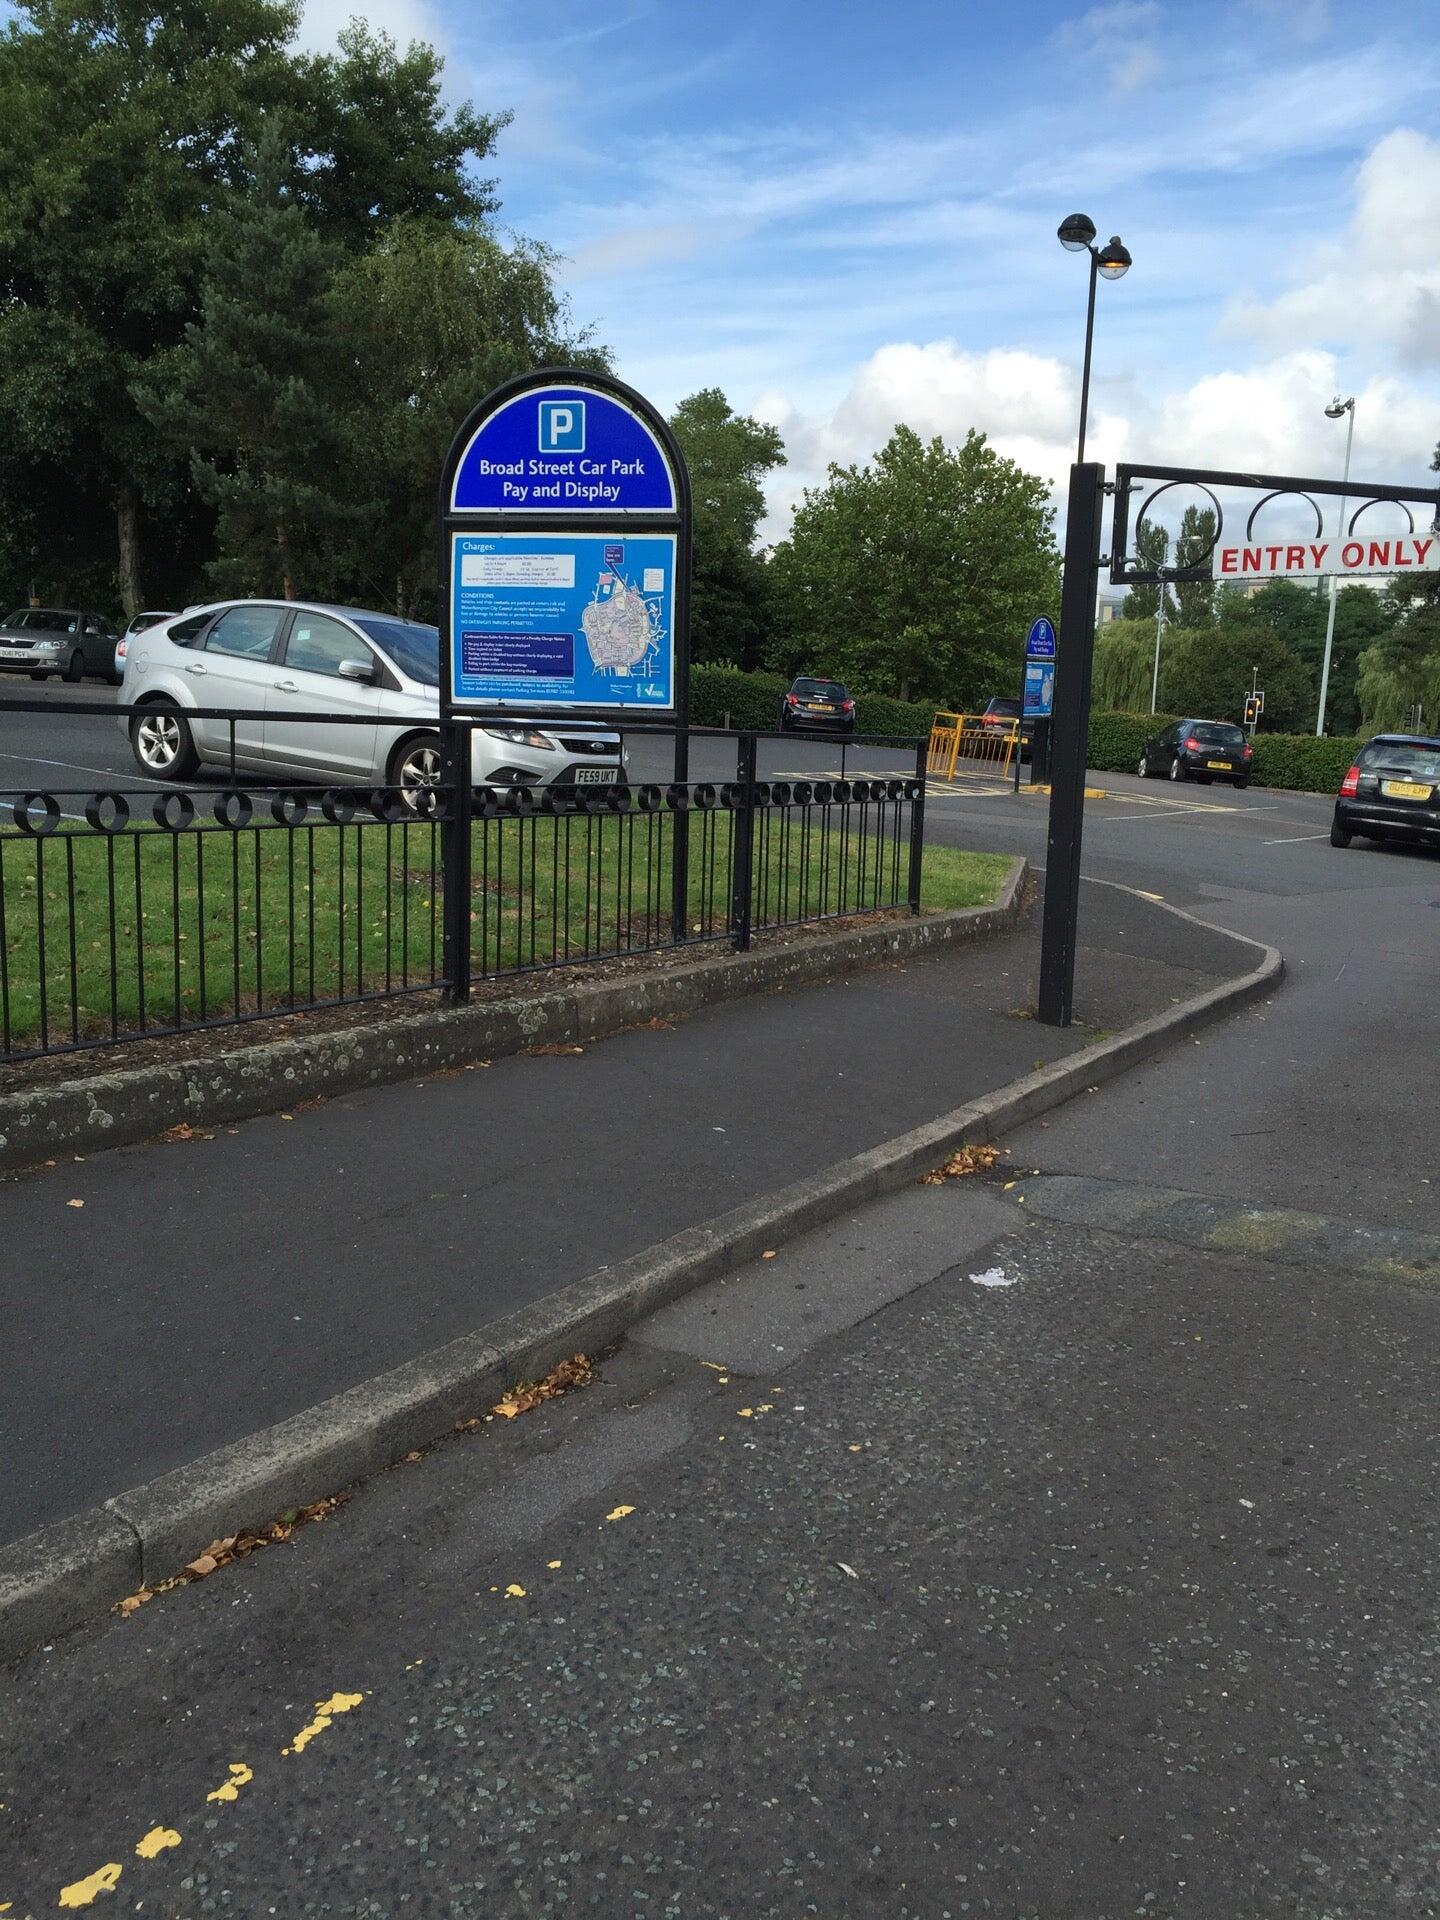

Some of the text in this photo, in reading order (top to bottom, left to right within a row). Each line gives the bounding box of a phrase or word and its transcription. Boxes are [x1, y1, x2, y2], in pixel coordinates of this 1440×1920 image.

[550, 408, 574, 445] P
[480, 459, 644, 475] Broad Street Car Park
[503, 482, 620, 501] Pay and Display
[462, 542, 496, 552] Charges:
[1221, 539, 1434, 572] ENTRY ONLY
[578, 770, 600, 782] FE59
